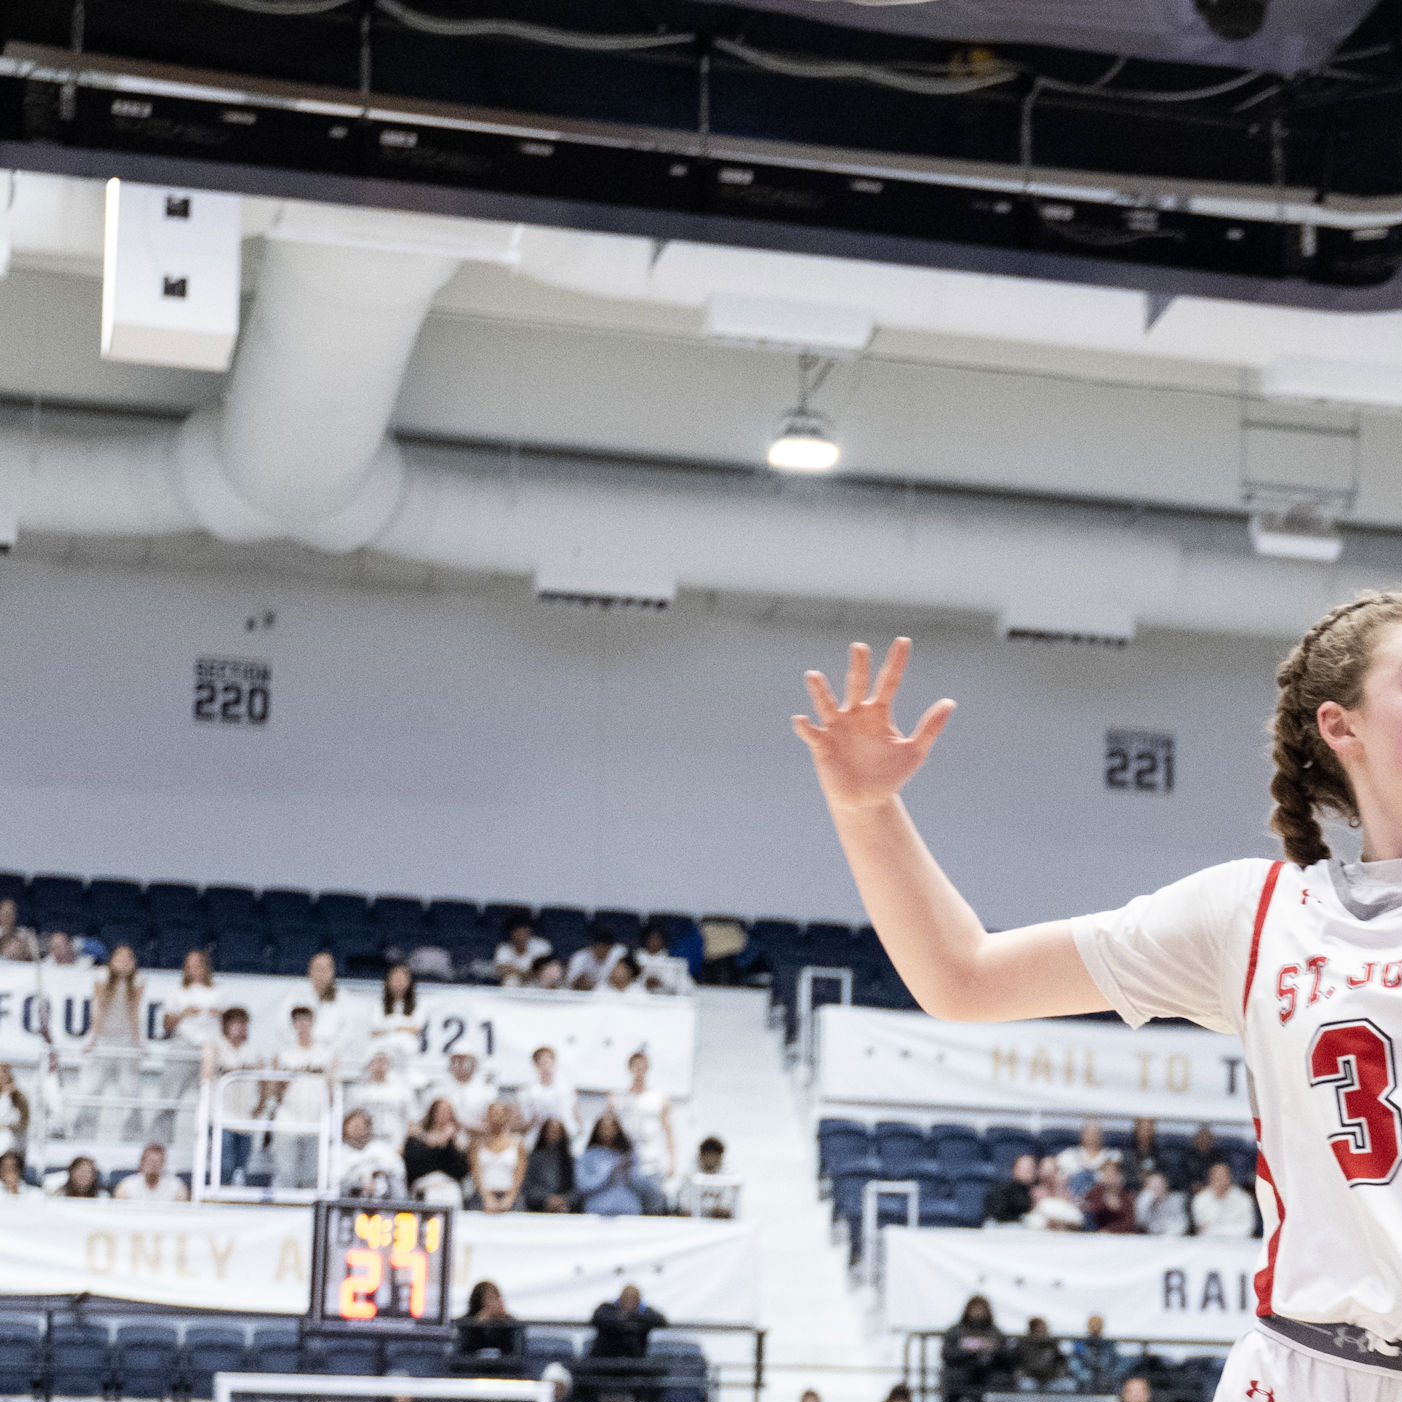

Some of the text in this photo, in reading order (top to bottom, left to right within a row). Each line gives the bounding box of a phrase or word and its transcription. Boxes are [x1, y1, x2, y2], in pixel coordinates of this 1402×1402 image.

[194, 682, 270, 725] 220
[1106, 750, 1175, 792] 221
[1276, 954, 1336, 1027] ST.
[990, 1045, 1102, 1087] HAIL
[1132, 1051, 1191, 1095] TO
[84, 1229, 307, 1284] ONLY A
[354, 1211, 441, 1254] 4:31
[339, 1248, 429, 1320] 27
[1163, 1267, 1247, 1313] RAI
